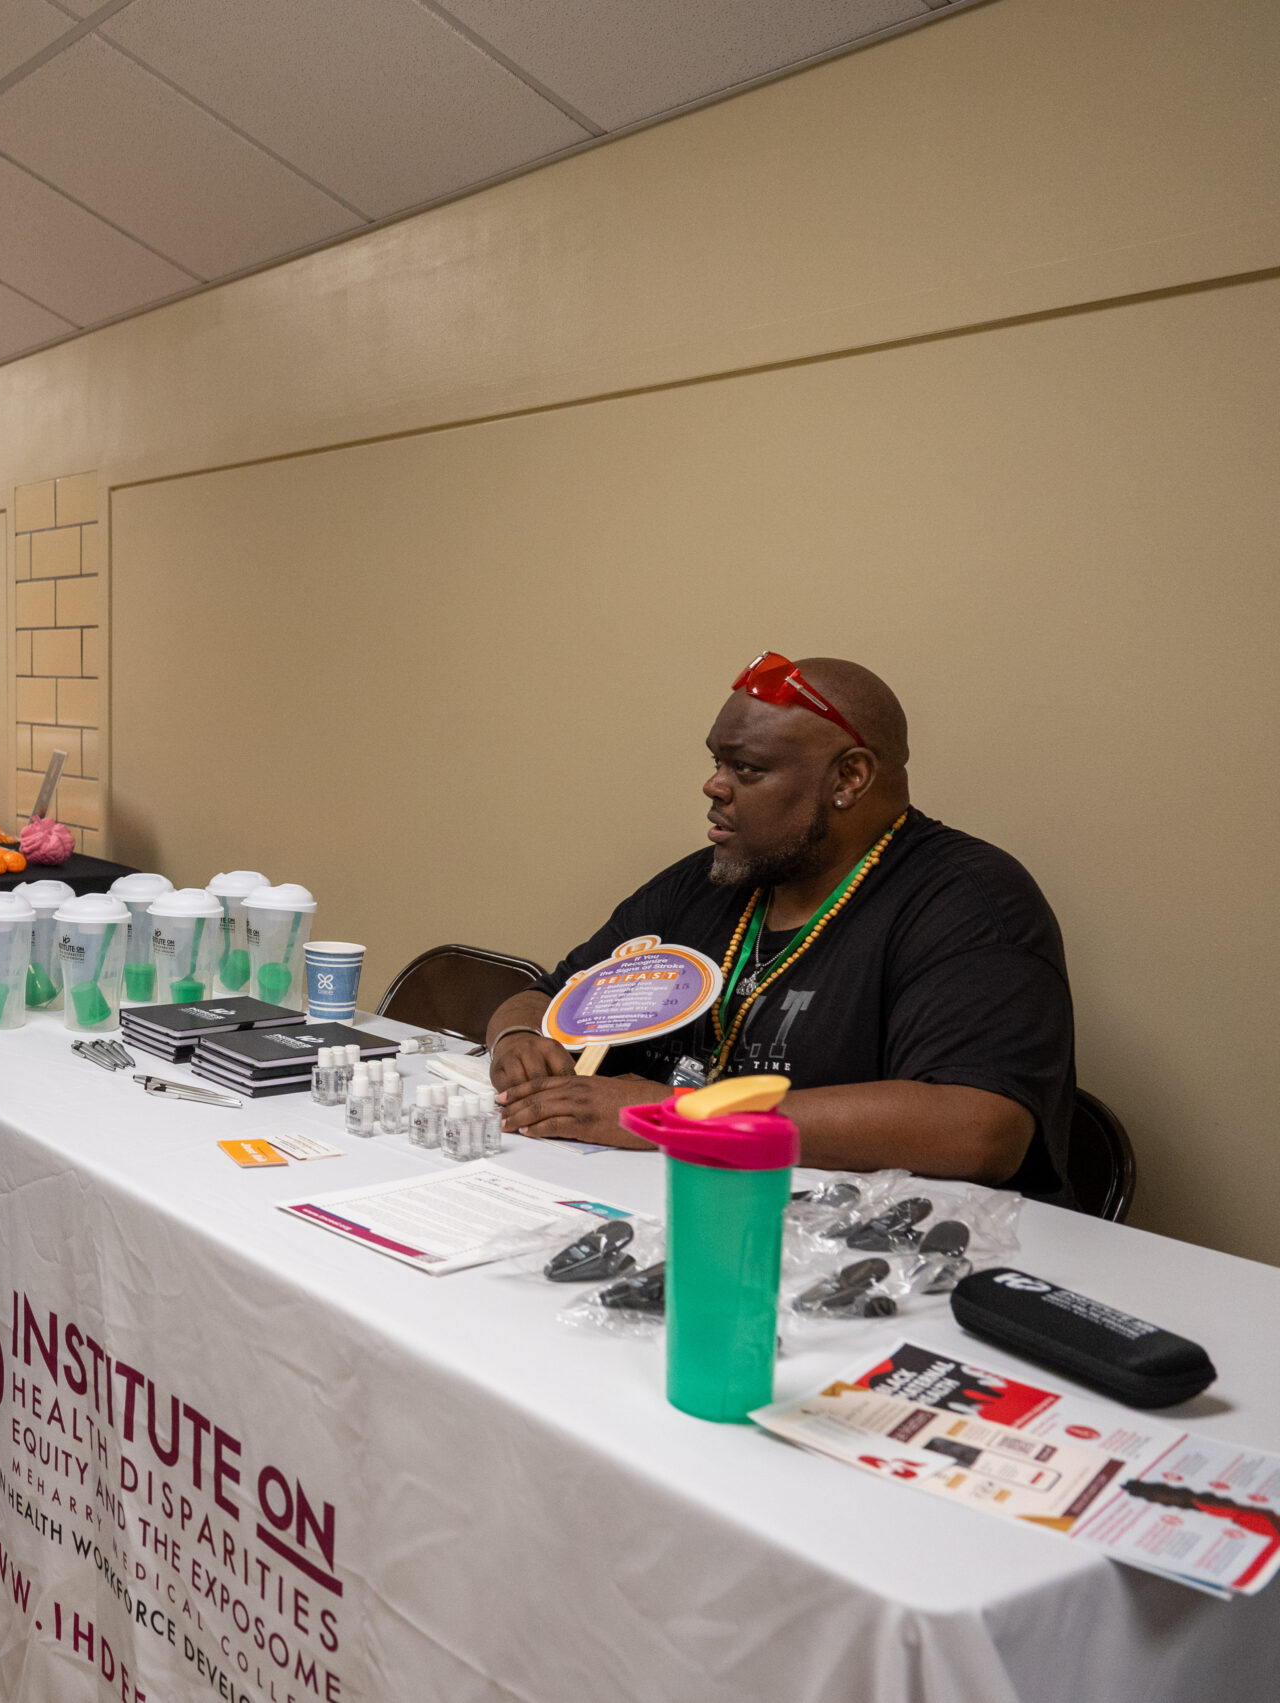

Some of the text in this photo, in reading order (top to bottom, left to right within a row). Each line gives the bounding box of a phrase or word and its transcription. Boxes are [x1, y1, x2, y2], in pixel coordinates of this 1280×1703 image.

[595, 971, 676, 986] BE FAST
[615, 966, 640, 974] Signs
[620, 959, 668, 968] Recognize
[753, 1061, 791, 1071] TIME
[12, 1371, 108, 1470] HEALTH
[12, 1290, 336, 1574] INSTITUTE ON
[9, 1487, 62, 1545] HEALTH
[72, 1531, 176, 1646] WORKFORCE
[12, 1458, 102, 1532] MEHARRY
[113, 1536, 203, 1632] MEDICAL
[12, 1418, 341, 1703] EQUITY AND THE EXPOSOME
[120, 1455, 339, 1653] DISPARITIES
